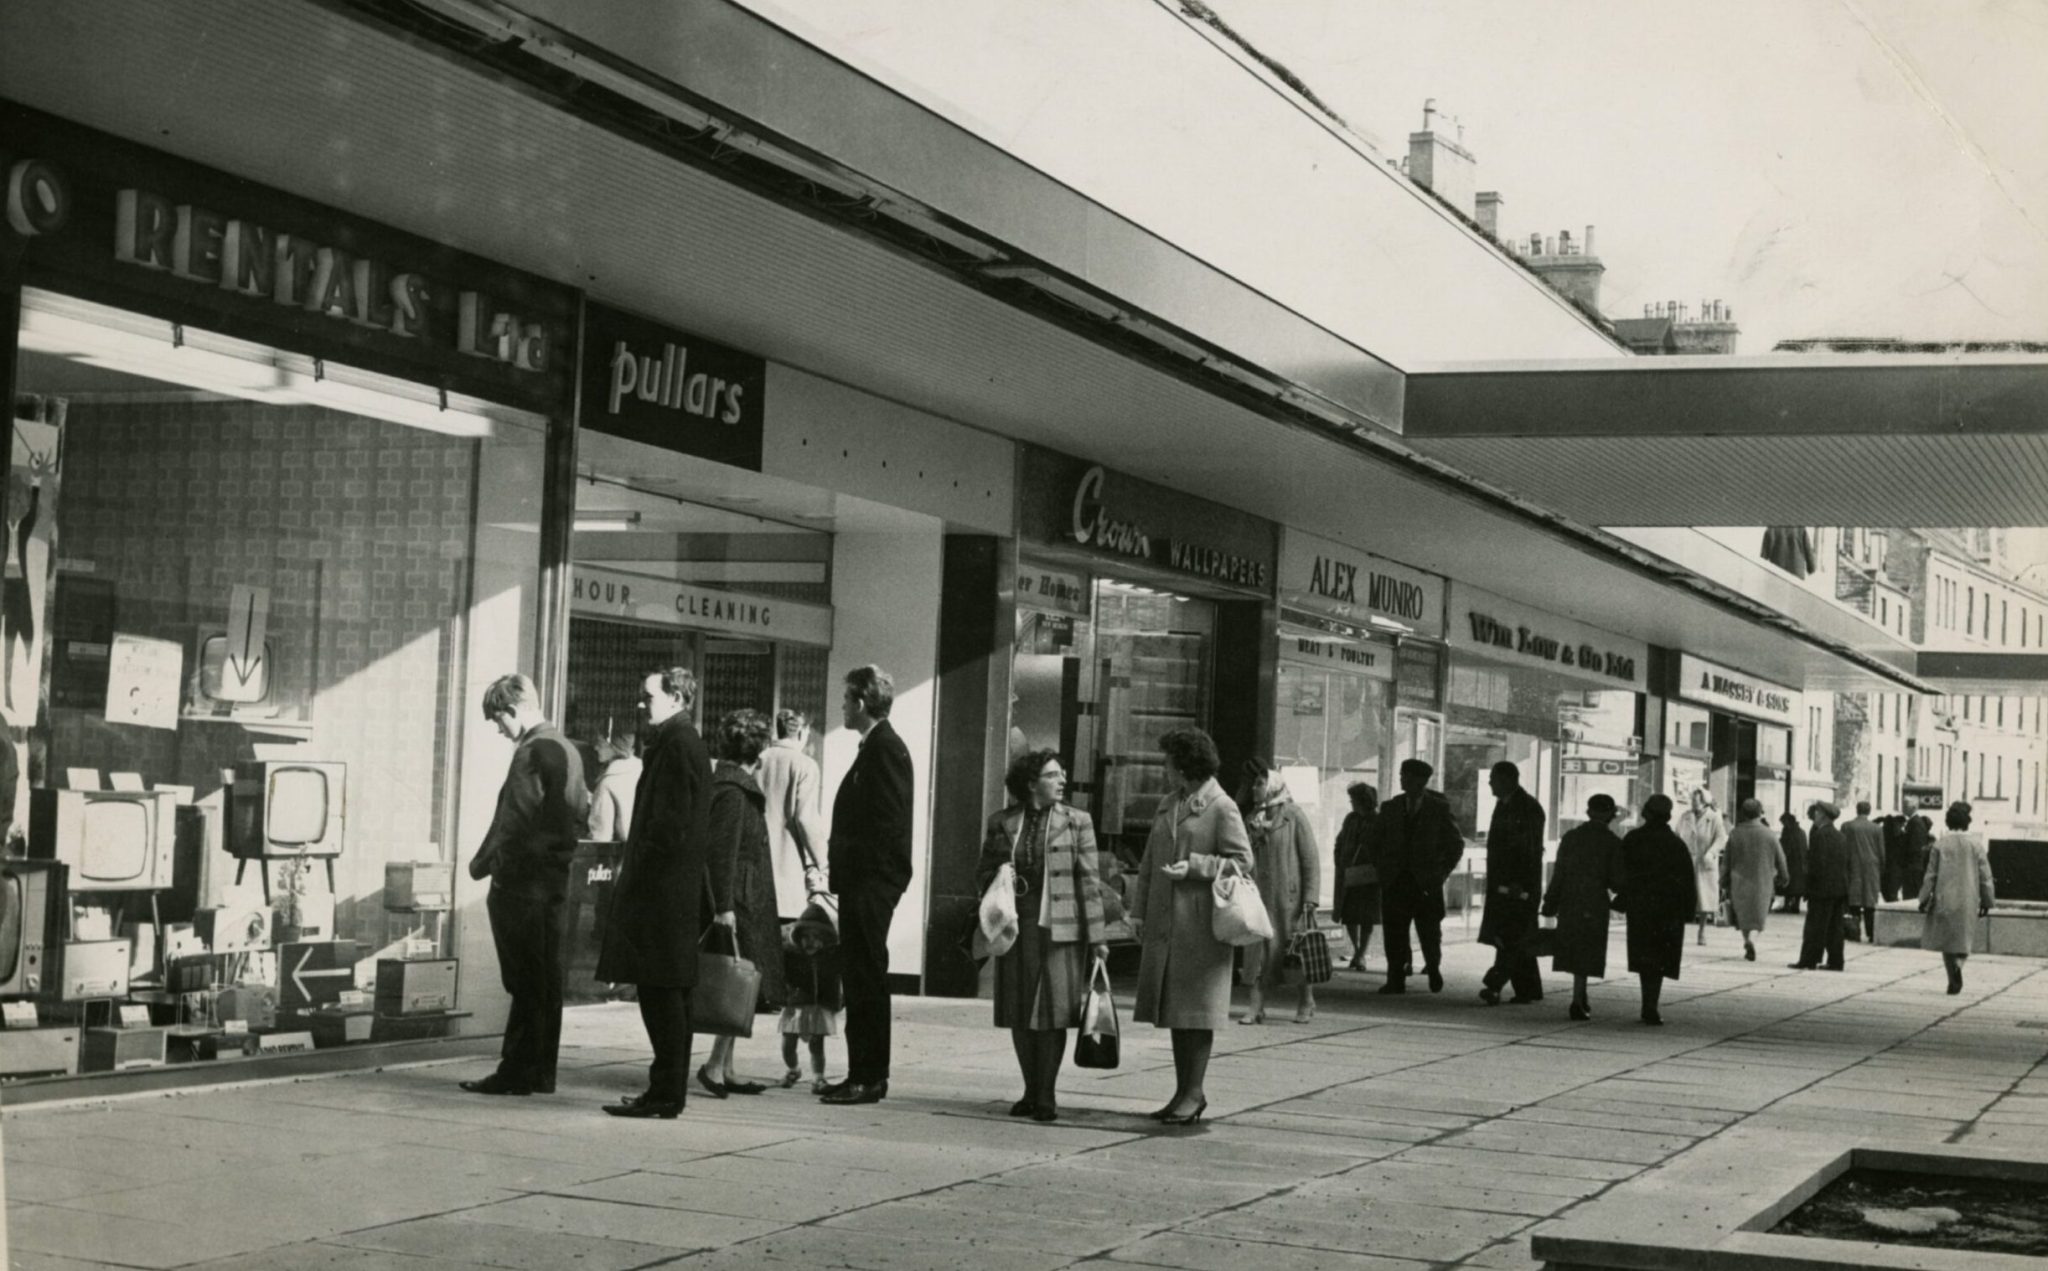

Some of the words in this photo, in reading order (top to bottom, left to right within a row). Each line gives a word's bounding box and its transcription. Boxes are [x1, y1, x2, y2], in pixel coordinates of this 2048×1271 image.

[115, 189, 430, 337] RENTALS
[457, 291, 548, 373] Ltd
[608, 341, 743, 424] pullars
[1073, 466, 1150, 559] Crown
[1169, 538, 1264, 586] WALLPAPERS
[573, 577, 631, 604] HOUR
[676, 594, 771, 626] CLEANING
[1309, 554, 1358, 604] ALEX
[1368, 571, 1424, 620] MUNRO
[1297, 638, 1320, 656] MEAT
[1341, 647, 1376, 667] POULTRY
[1701, 671, 1709, 689] A
[1766, 692, 1790, 714] SONS
